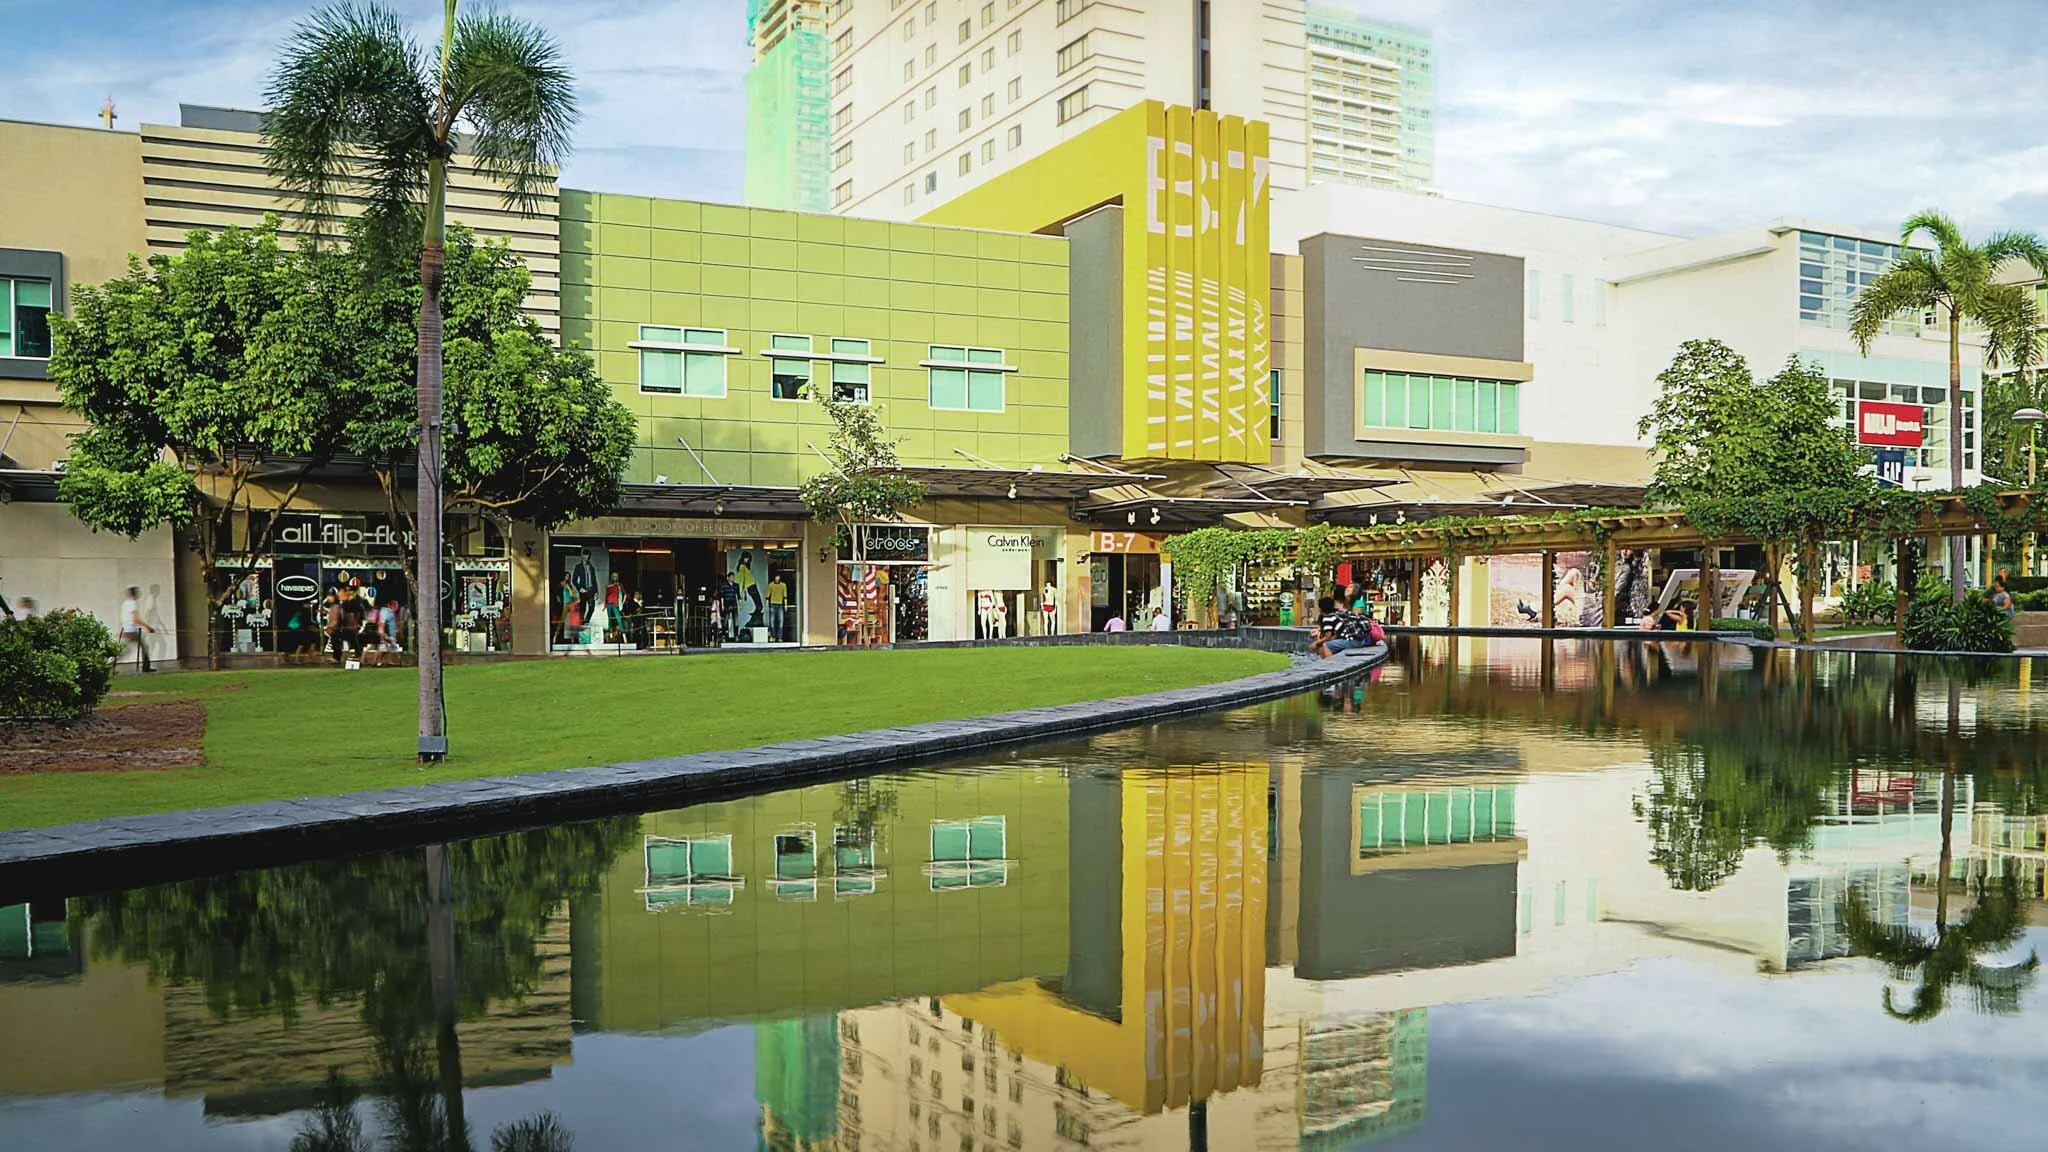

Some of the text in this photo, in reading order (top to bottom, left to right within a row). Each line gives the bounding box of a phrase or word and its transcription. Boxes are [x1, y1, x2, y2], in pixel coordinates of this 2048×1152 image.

[1884, 461, 1901, 481] GAP
[282, 523, 445, 550] all flip-flop
[865, 538, 915, 551] crocs
[987, 534, 1045, 547] Calvin Klein
[1101, 532, 1136, 553] B-7
